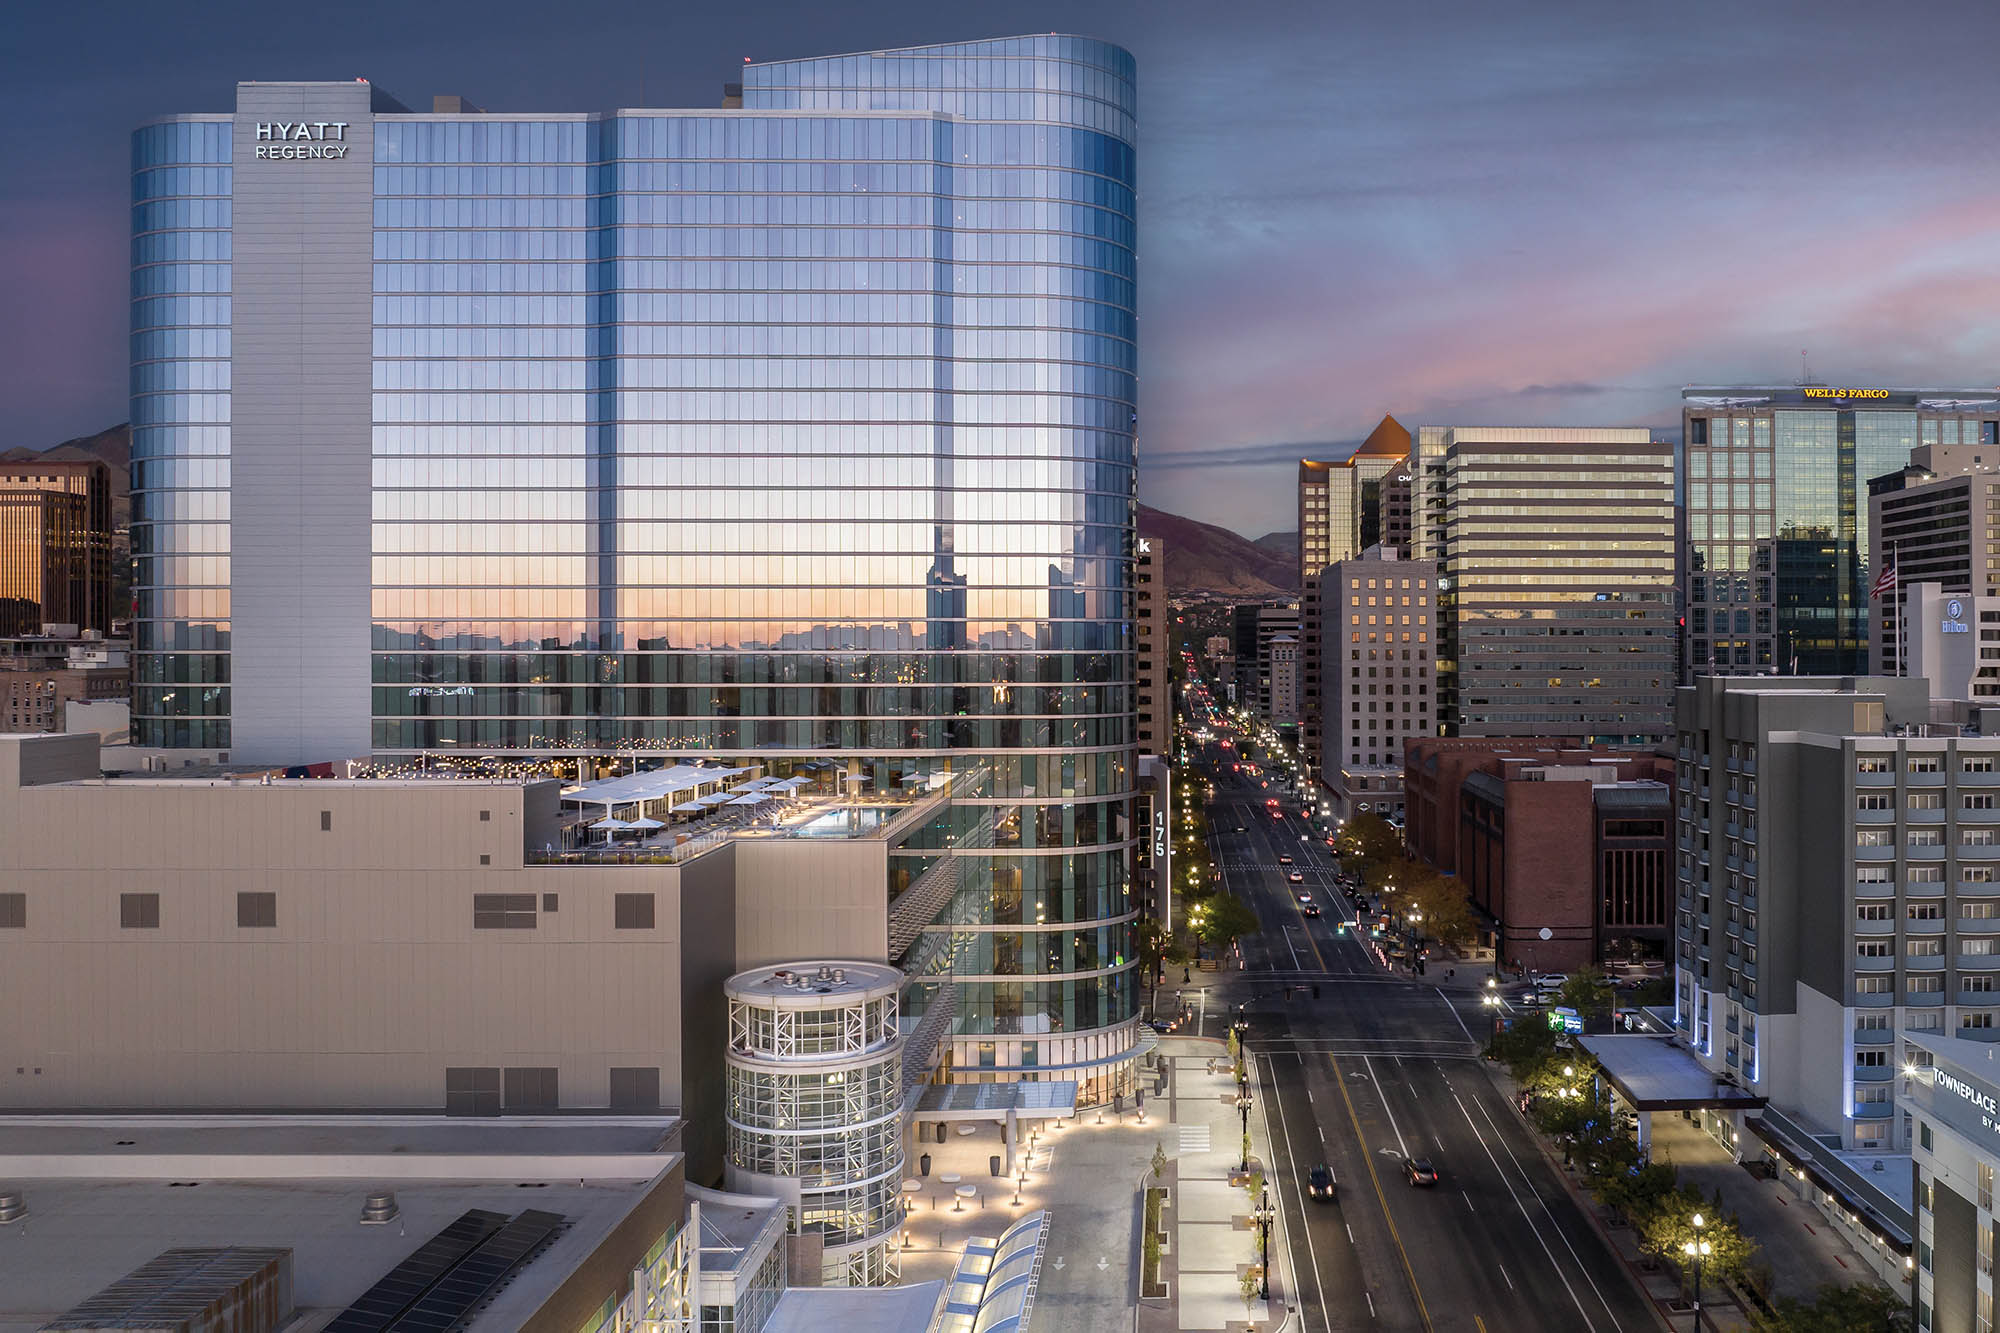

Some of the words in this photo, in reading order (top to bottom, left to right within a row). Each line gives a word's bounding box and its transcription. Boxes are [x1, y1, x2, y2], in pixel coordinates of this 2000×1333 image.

[256, 122, 348, 140] HYATT
[255, 145, 348, 159] REGENCY
[1804, 388, 1846, 398] WELLS
[1848, 388, 1889, 399] FARGO
[1137, 538, 1151, 553] k
[1155, 811, 1165, 857] 175
[1933, 1067, 1997, 1115] TOWNEPLACE
[1982, 1115, 1993, 1129] BY
